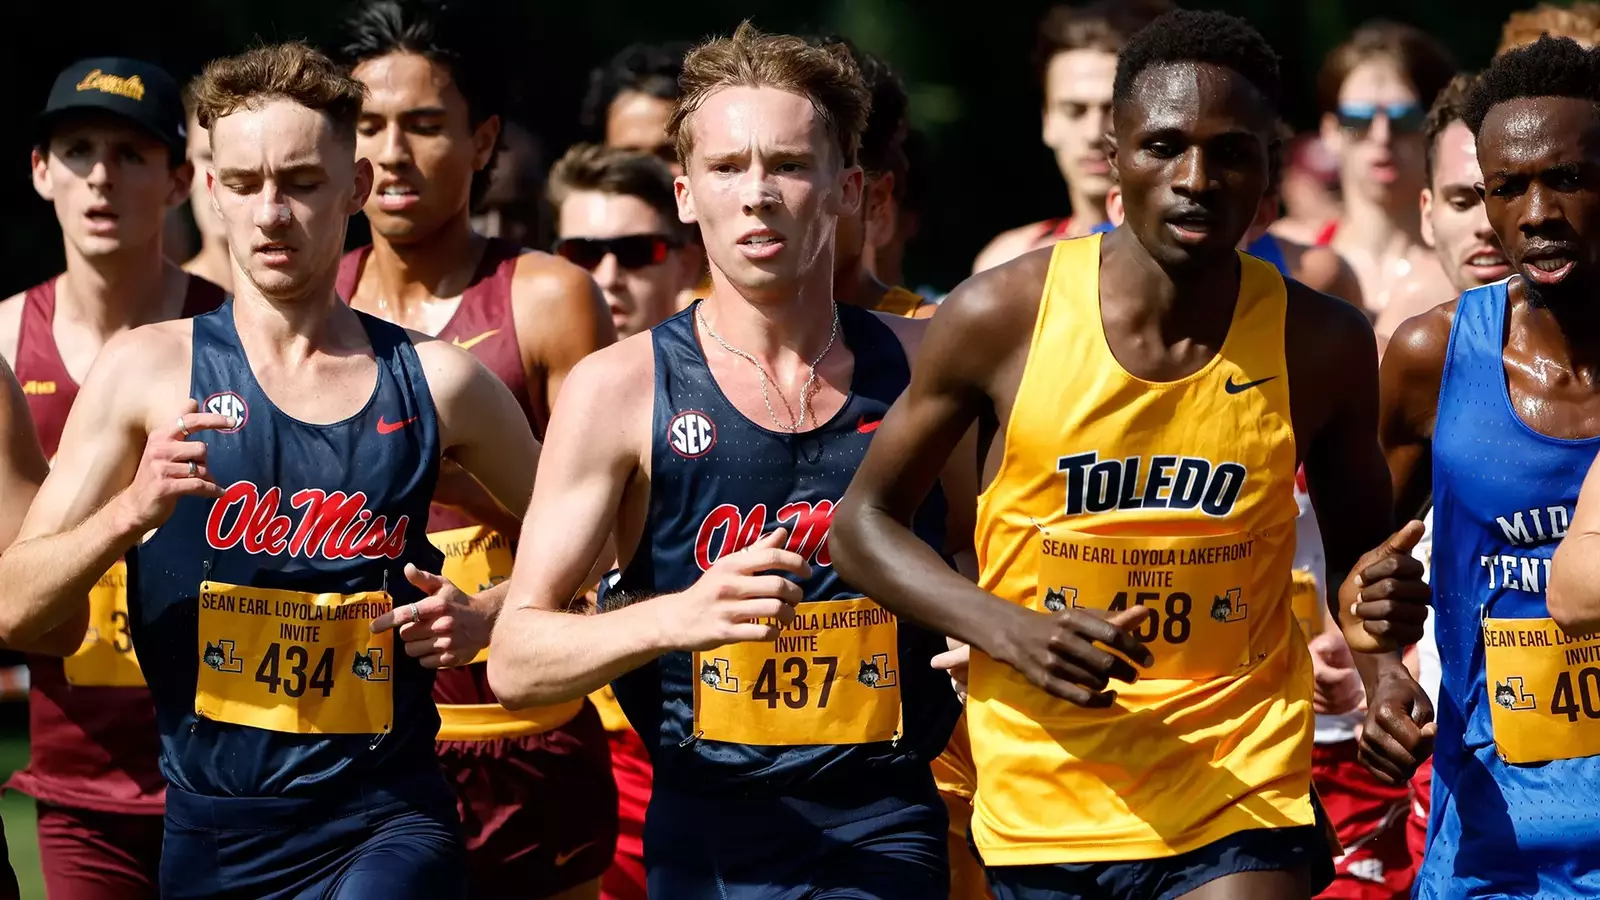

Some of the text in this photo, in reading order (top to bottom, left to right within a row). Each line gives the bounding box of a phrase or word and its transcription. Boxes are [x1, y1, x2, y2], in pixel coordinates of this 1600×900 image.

[671, 414, 712, 454] SEC
[206, 480, 410, 560] Ole Miss
[1042, 539, 1254, 566] SEAN EARL LOYOLA LAKEFRONT
[1127, 571, 1174, 588] INVITE
[201, 593, 235, 613] SEAN
[239, 599, 272, 616] EARL
[275, 601, 324, 621] LOYOLA
[279, 622, 321, 643] INVITE
[774, 635, 819, 654] INVITE
[1484, 628, 1517, 647] SEAN
[1518, 630, 1553, 647] EARL
[254, 642, 336, 698] 434
[751, 656, 839, 709] 437
